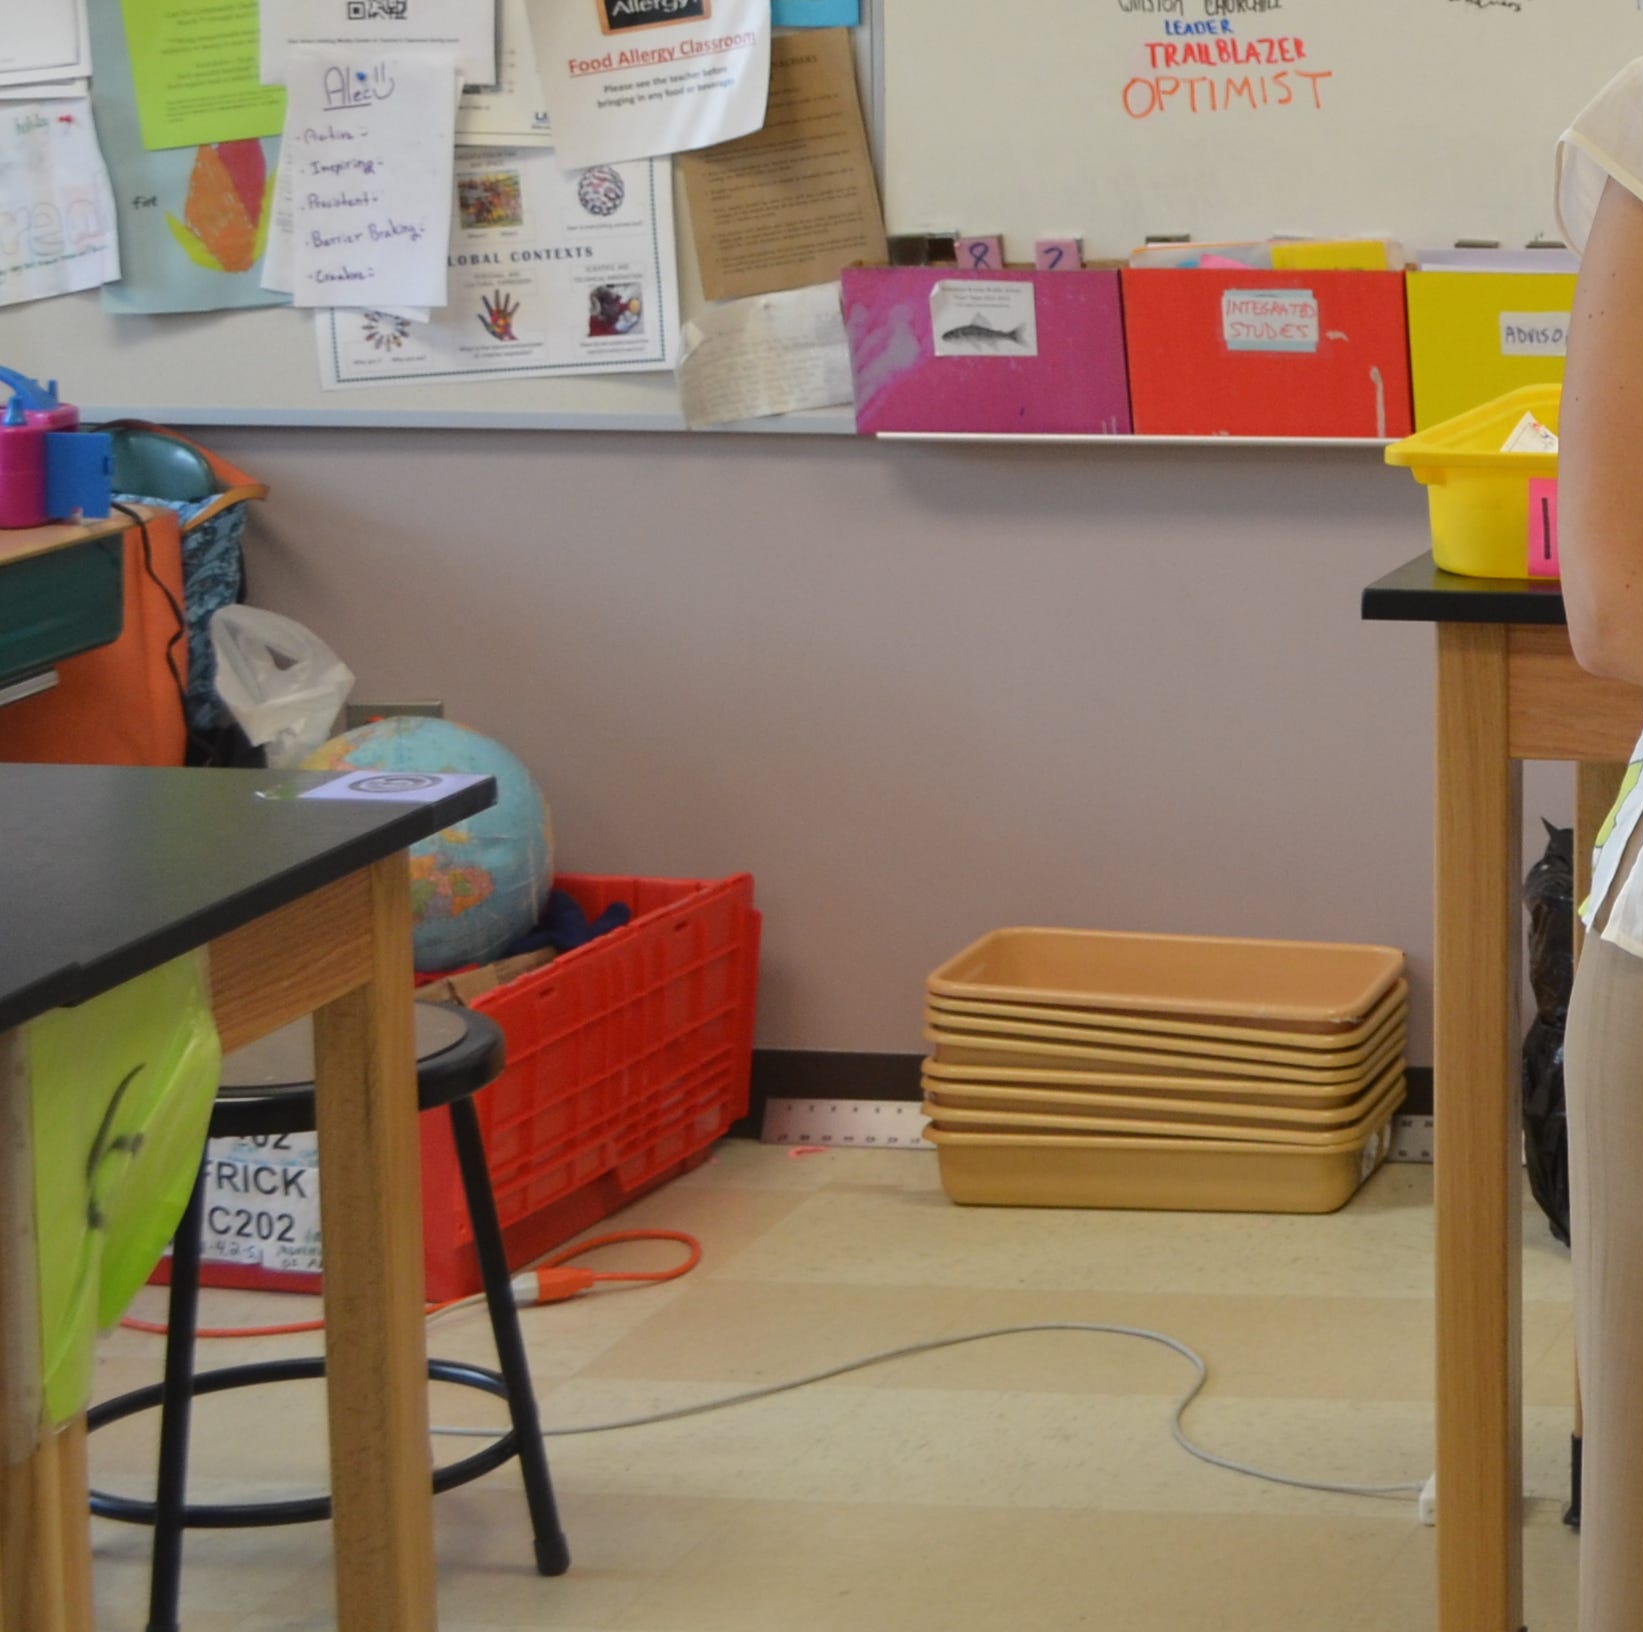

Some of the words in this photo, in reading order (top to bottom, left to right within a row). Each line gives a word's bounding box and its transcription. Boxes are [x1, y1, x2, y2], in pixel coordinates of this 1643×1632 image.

[1163, 18, 1235, 36] LEADER
[568, 52, 614, 76] Food
[618, 44, 676, 68] Allergy
[679, 31, 757, 56] Classroom
[1144, 37, 1307, 70] TRAILBLAZER
[603, 82, 633, 94] Please
[635, 79, 651, 89] see
[653, 76, 667, 87] the
[1121, 69, 1334, 120] OPTIMIST
[510, 246, 594, 262] CONTEXTS
[1504, 325, 1568, 345] ADVISO
[208, 1205, 296, 1243] C202
